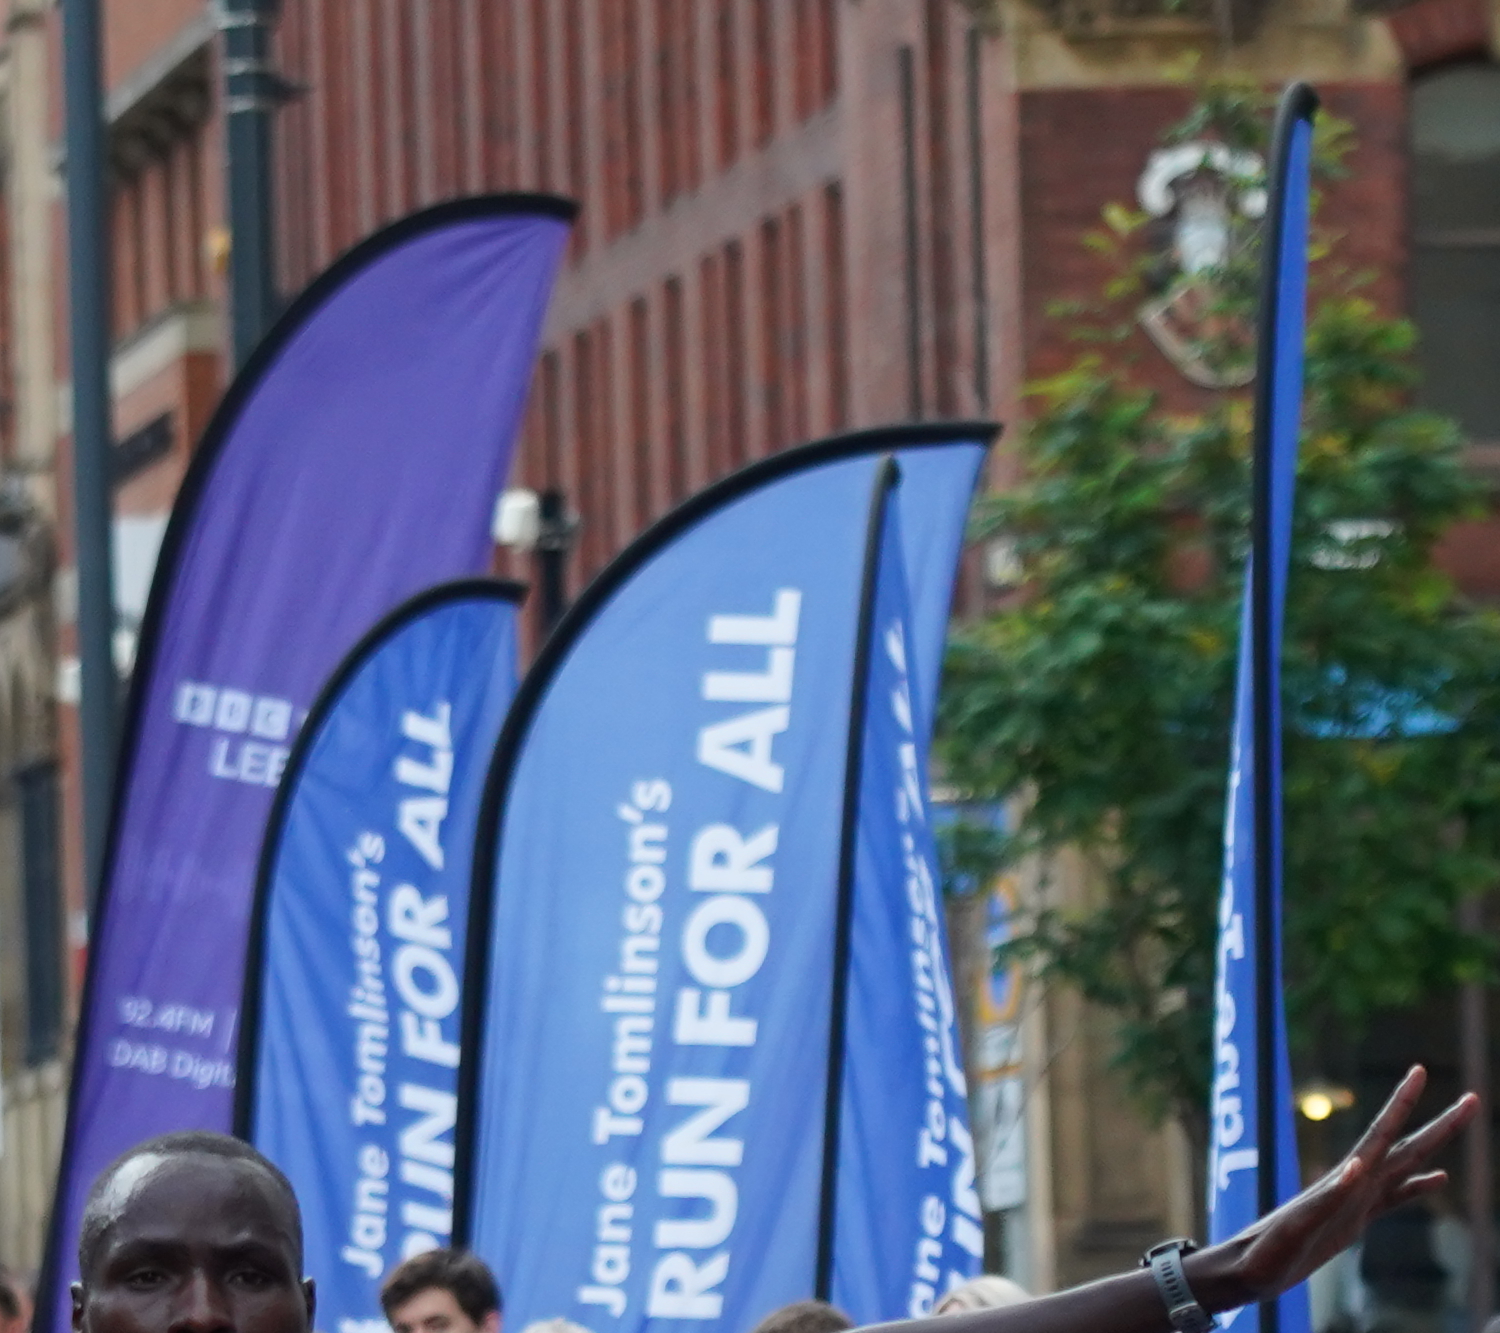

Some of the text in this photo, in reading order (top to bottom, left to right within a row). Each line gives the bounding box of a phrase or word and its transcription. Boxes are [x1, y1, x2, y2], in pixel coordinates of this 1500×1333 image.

[394, 702, 455, 872] ALL
[341, 832, 391, 1280] Jane Tomlinson's
[391, 884, 461, 1068] FOR
[578, 778, 672, 1319] Jane Tomlinson's
[647, 587, 802, 1322] RUN FOR ALL
[907, 1195, 946, 1320] ane
